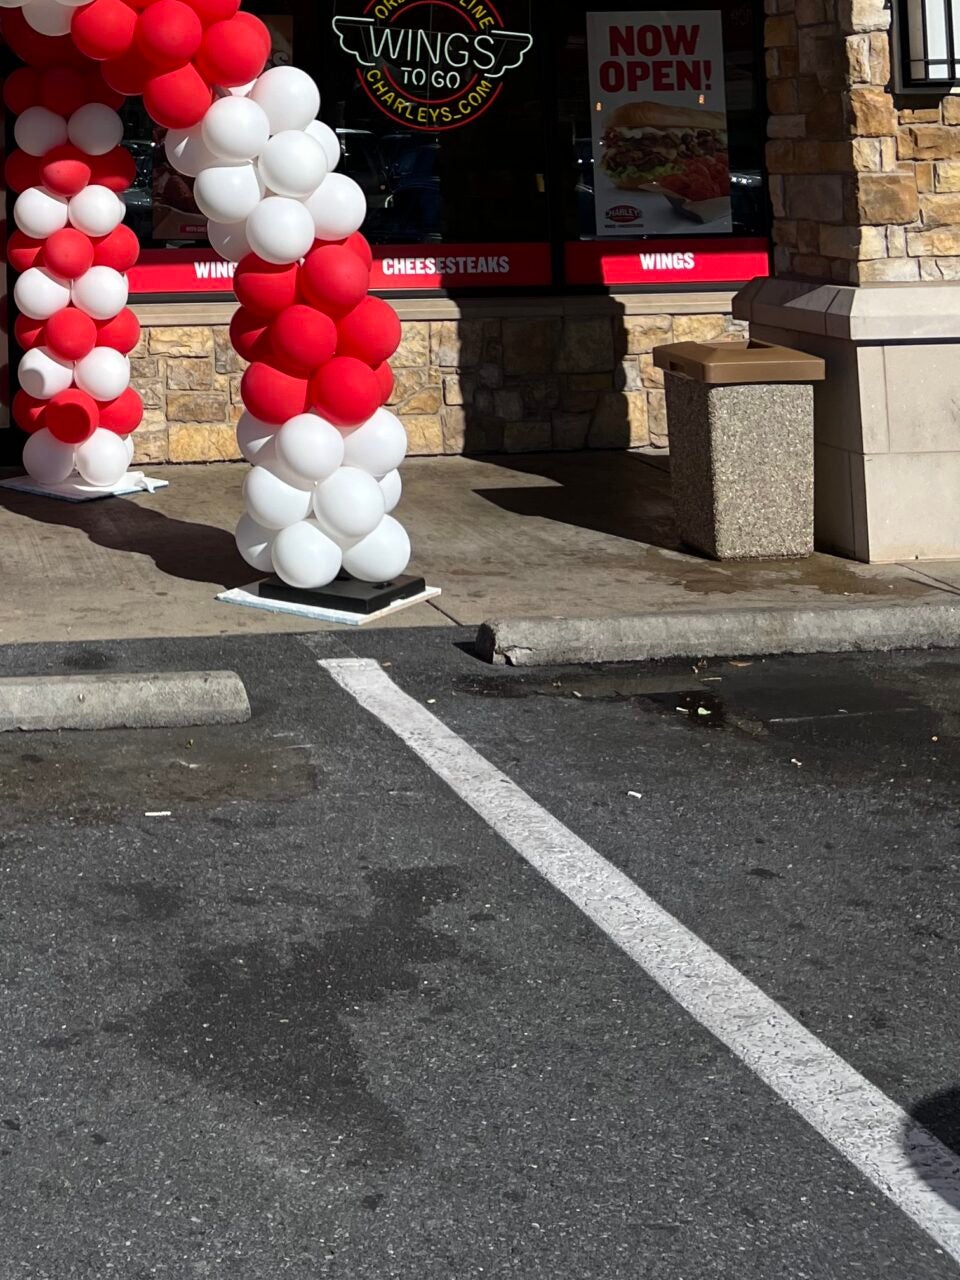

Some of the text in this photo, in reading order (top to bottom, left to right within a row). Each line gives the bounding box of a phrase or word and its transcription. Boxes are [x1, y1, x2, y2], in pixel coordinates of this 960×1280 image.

[370, 25, 495, 69] WINGS
[609, 24, 701, 56] NOW
[401, 67, 460, 88] TO GO
[599, 60, 712, 93] OPEN!
[194, 261, 239, 279] WING
[382, 256, 510, 276] CHEESESTEAKS
[640, 252, 695, 271] WINGS
